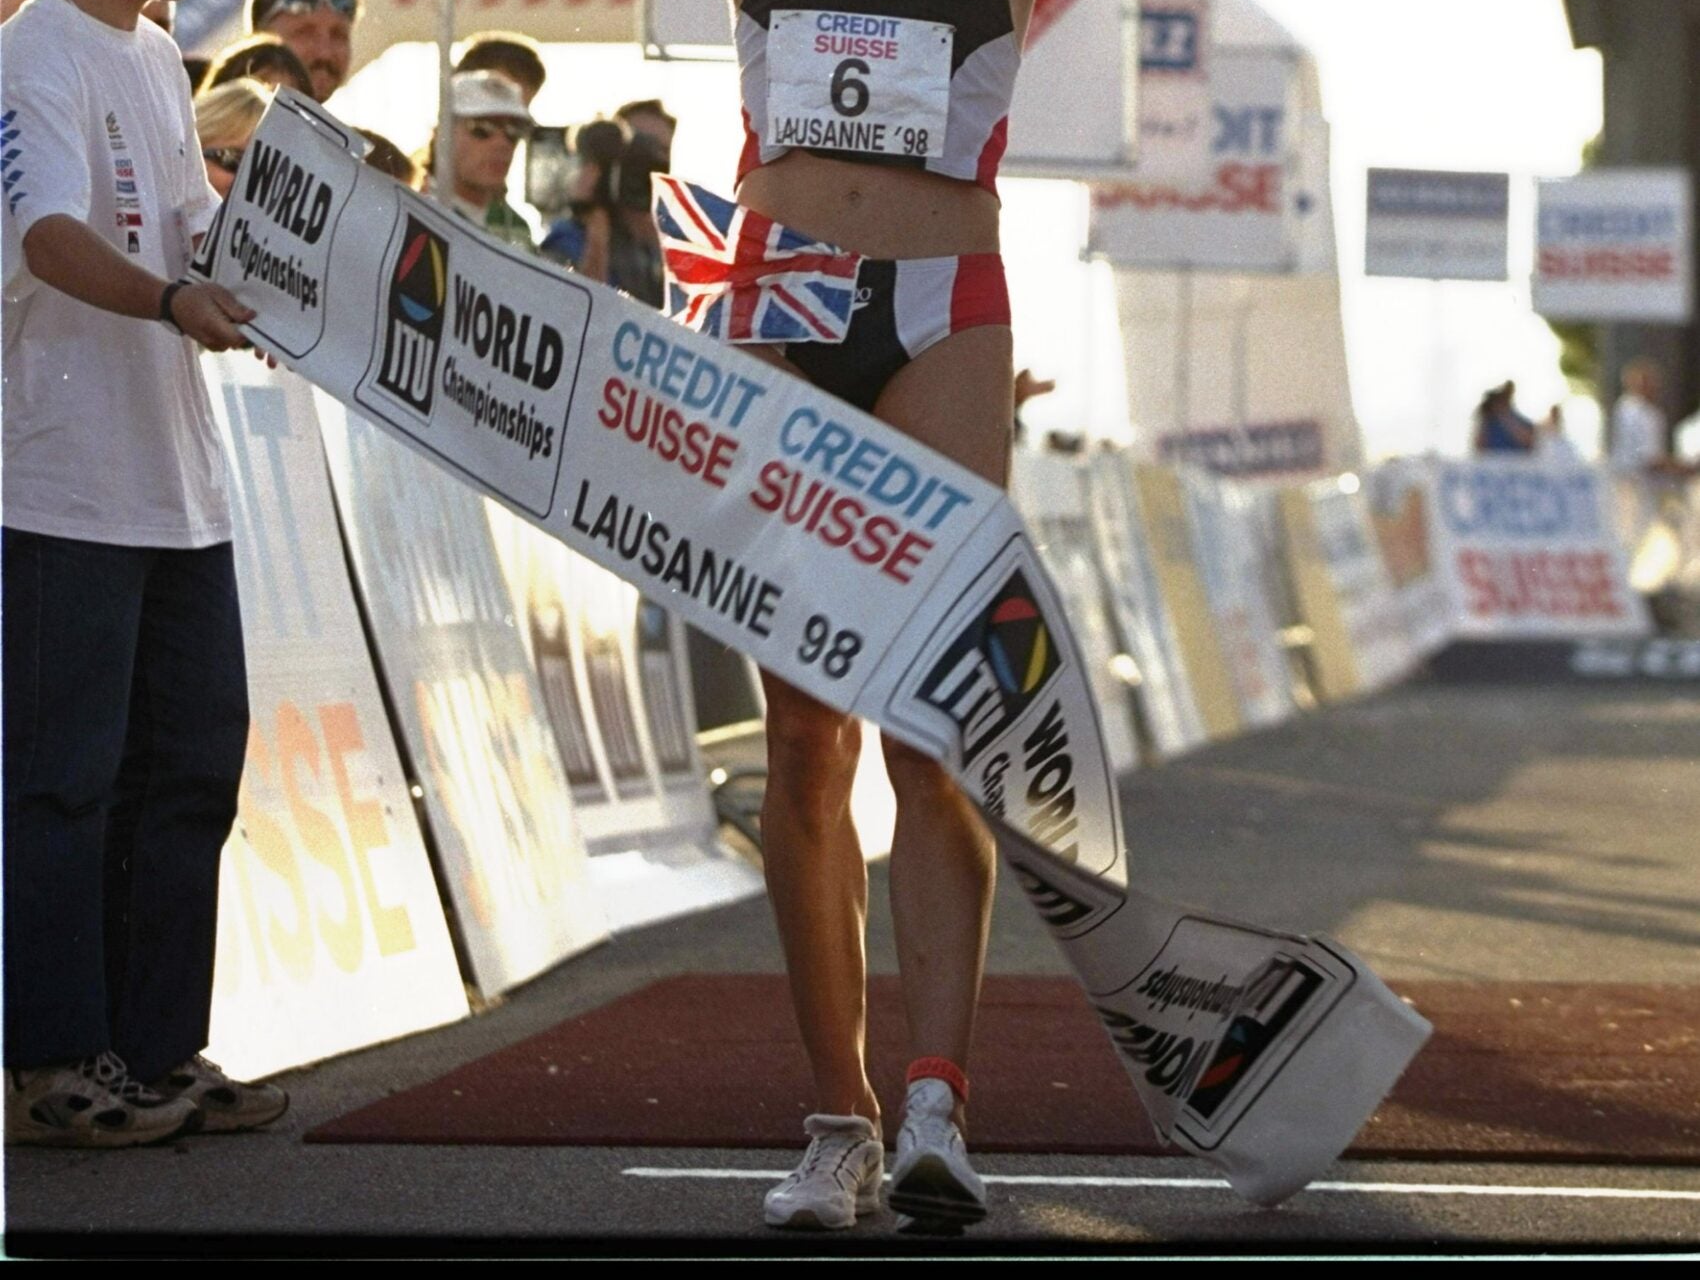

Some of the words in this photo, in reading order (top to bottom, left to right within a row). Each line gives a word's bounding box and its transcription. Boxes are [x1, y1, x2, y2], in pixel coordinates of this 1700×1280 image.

[813, 34, 899, 61] SUISSE
[816, 12, 901, 39] CREDIT
[774, 116, 886, 152] LAUSANNE
[830, 57, 871, 118] 6
[245, 139, 332, 245] WORLD
[387, 318, 435, 403] ITU
[454, 273, 564, 391] WORLD
[442, 356, 554, 460] Championships
[612, 320, 766, 429] CREDIT
[779, 406, 973, 532] CREDIT
[597, 377, 740, 489] SUISSE
[749, 460, 936, 584] SUISSE
[571, 479, 784, 639] LAUSANNE
[797, 613, 864, 681] 98
